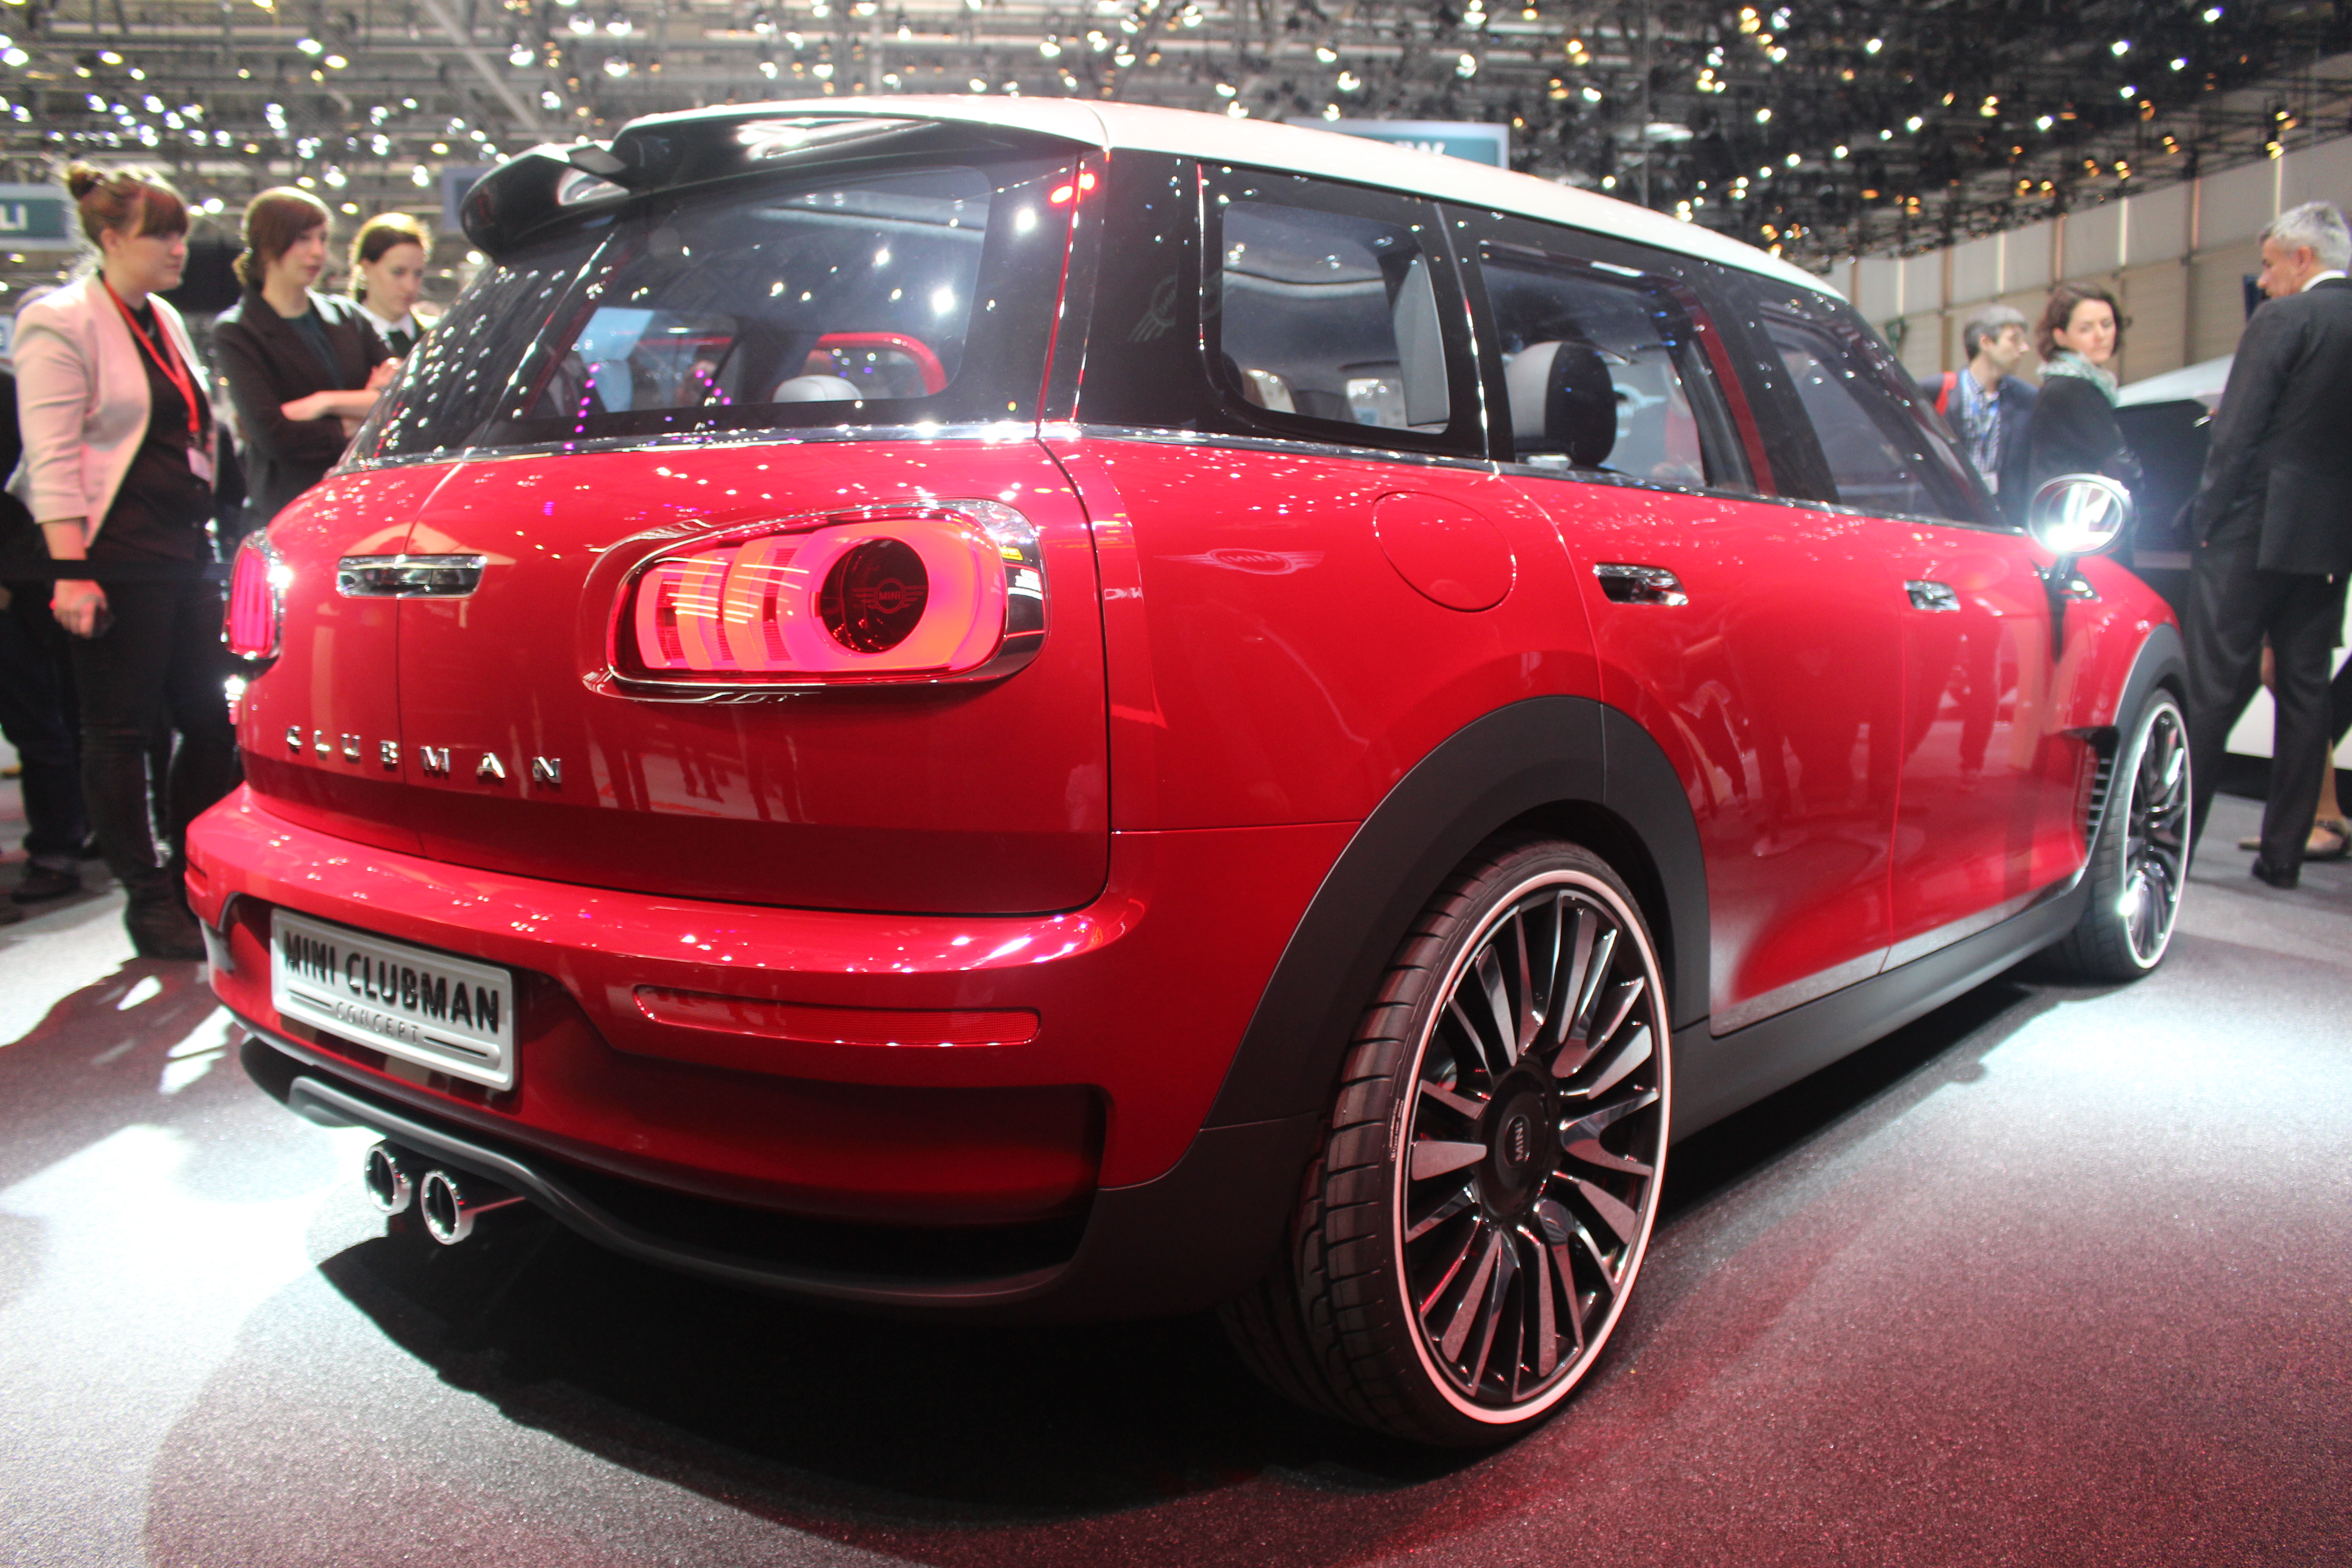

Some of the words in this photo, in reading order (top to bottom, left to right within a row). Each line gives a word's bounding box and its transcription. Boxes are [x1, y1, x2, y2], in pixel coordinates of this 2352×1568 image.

[879, 591, 901, 600] MINI
[286, 725, 562, 784] CLUBMAN
[284, 931, 336, 986] MINI
[346, 952, 499, 1034] CLUBMAN
[336, 1001, 419, 1043] CONCEPT
[1515, 1122, 1524, 1161] MINI
